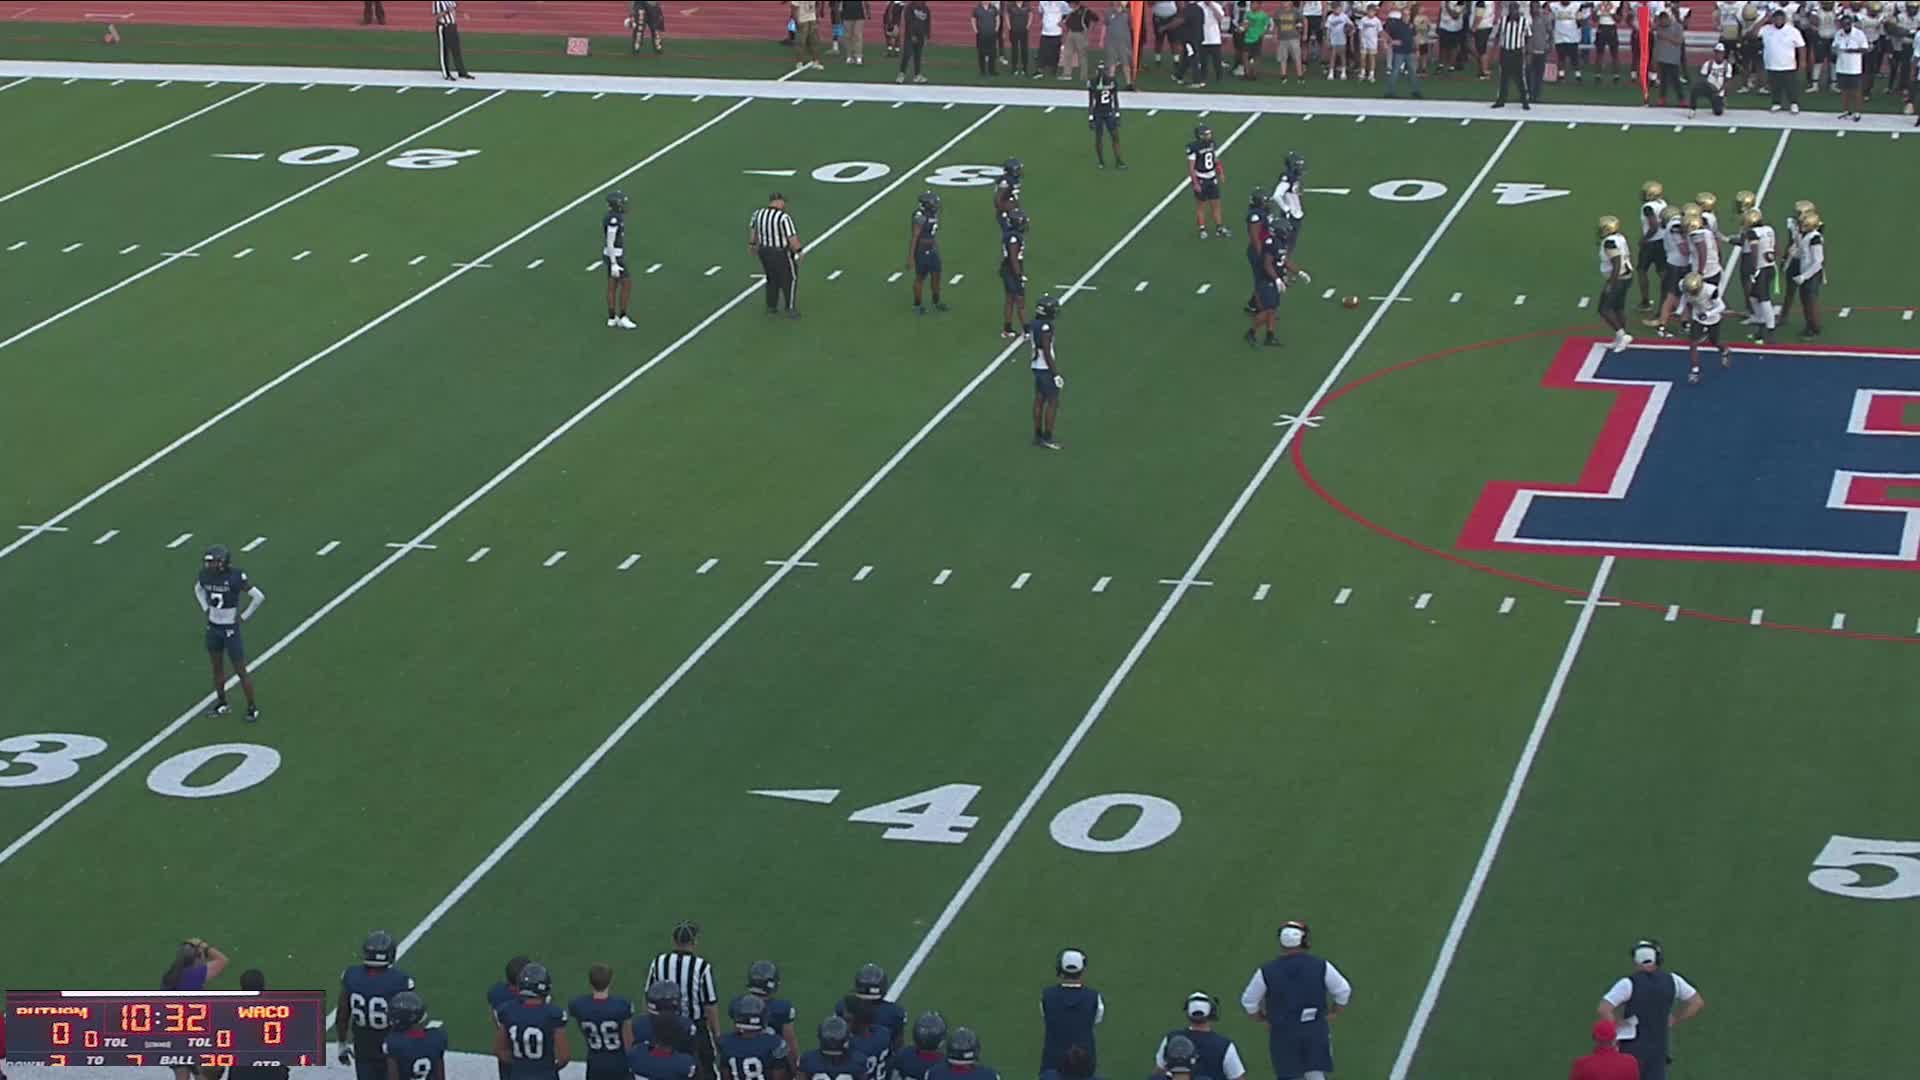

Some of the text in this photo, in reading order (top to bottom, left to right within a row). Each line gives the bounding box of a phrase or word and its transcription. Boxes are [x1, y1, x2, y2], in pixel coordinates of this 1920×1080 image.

[1204, 152, 1215, 170] 8
[350, 992, 389, 1030] 66
[509, 1025, 543, 1059] 10
[581, 1020, 621, 1051] 36
[412, 1056, 432, 1080] 9
[728, 1056, 765, 1080] 18
